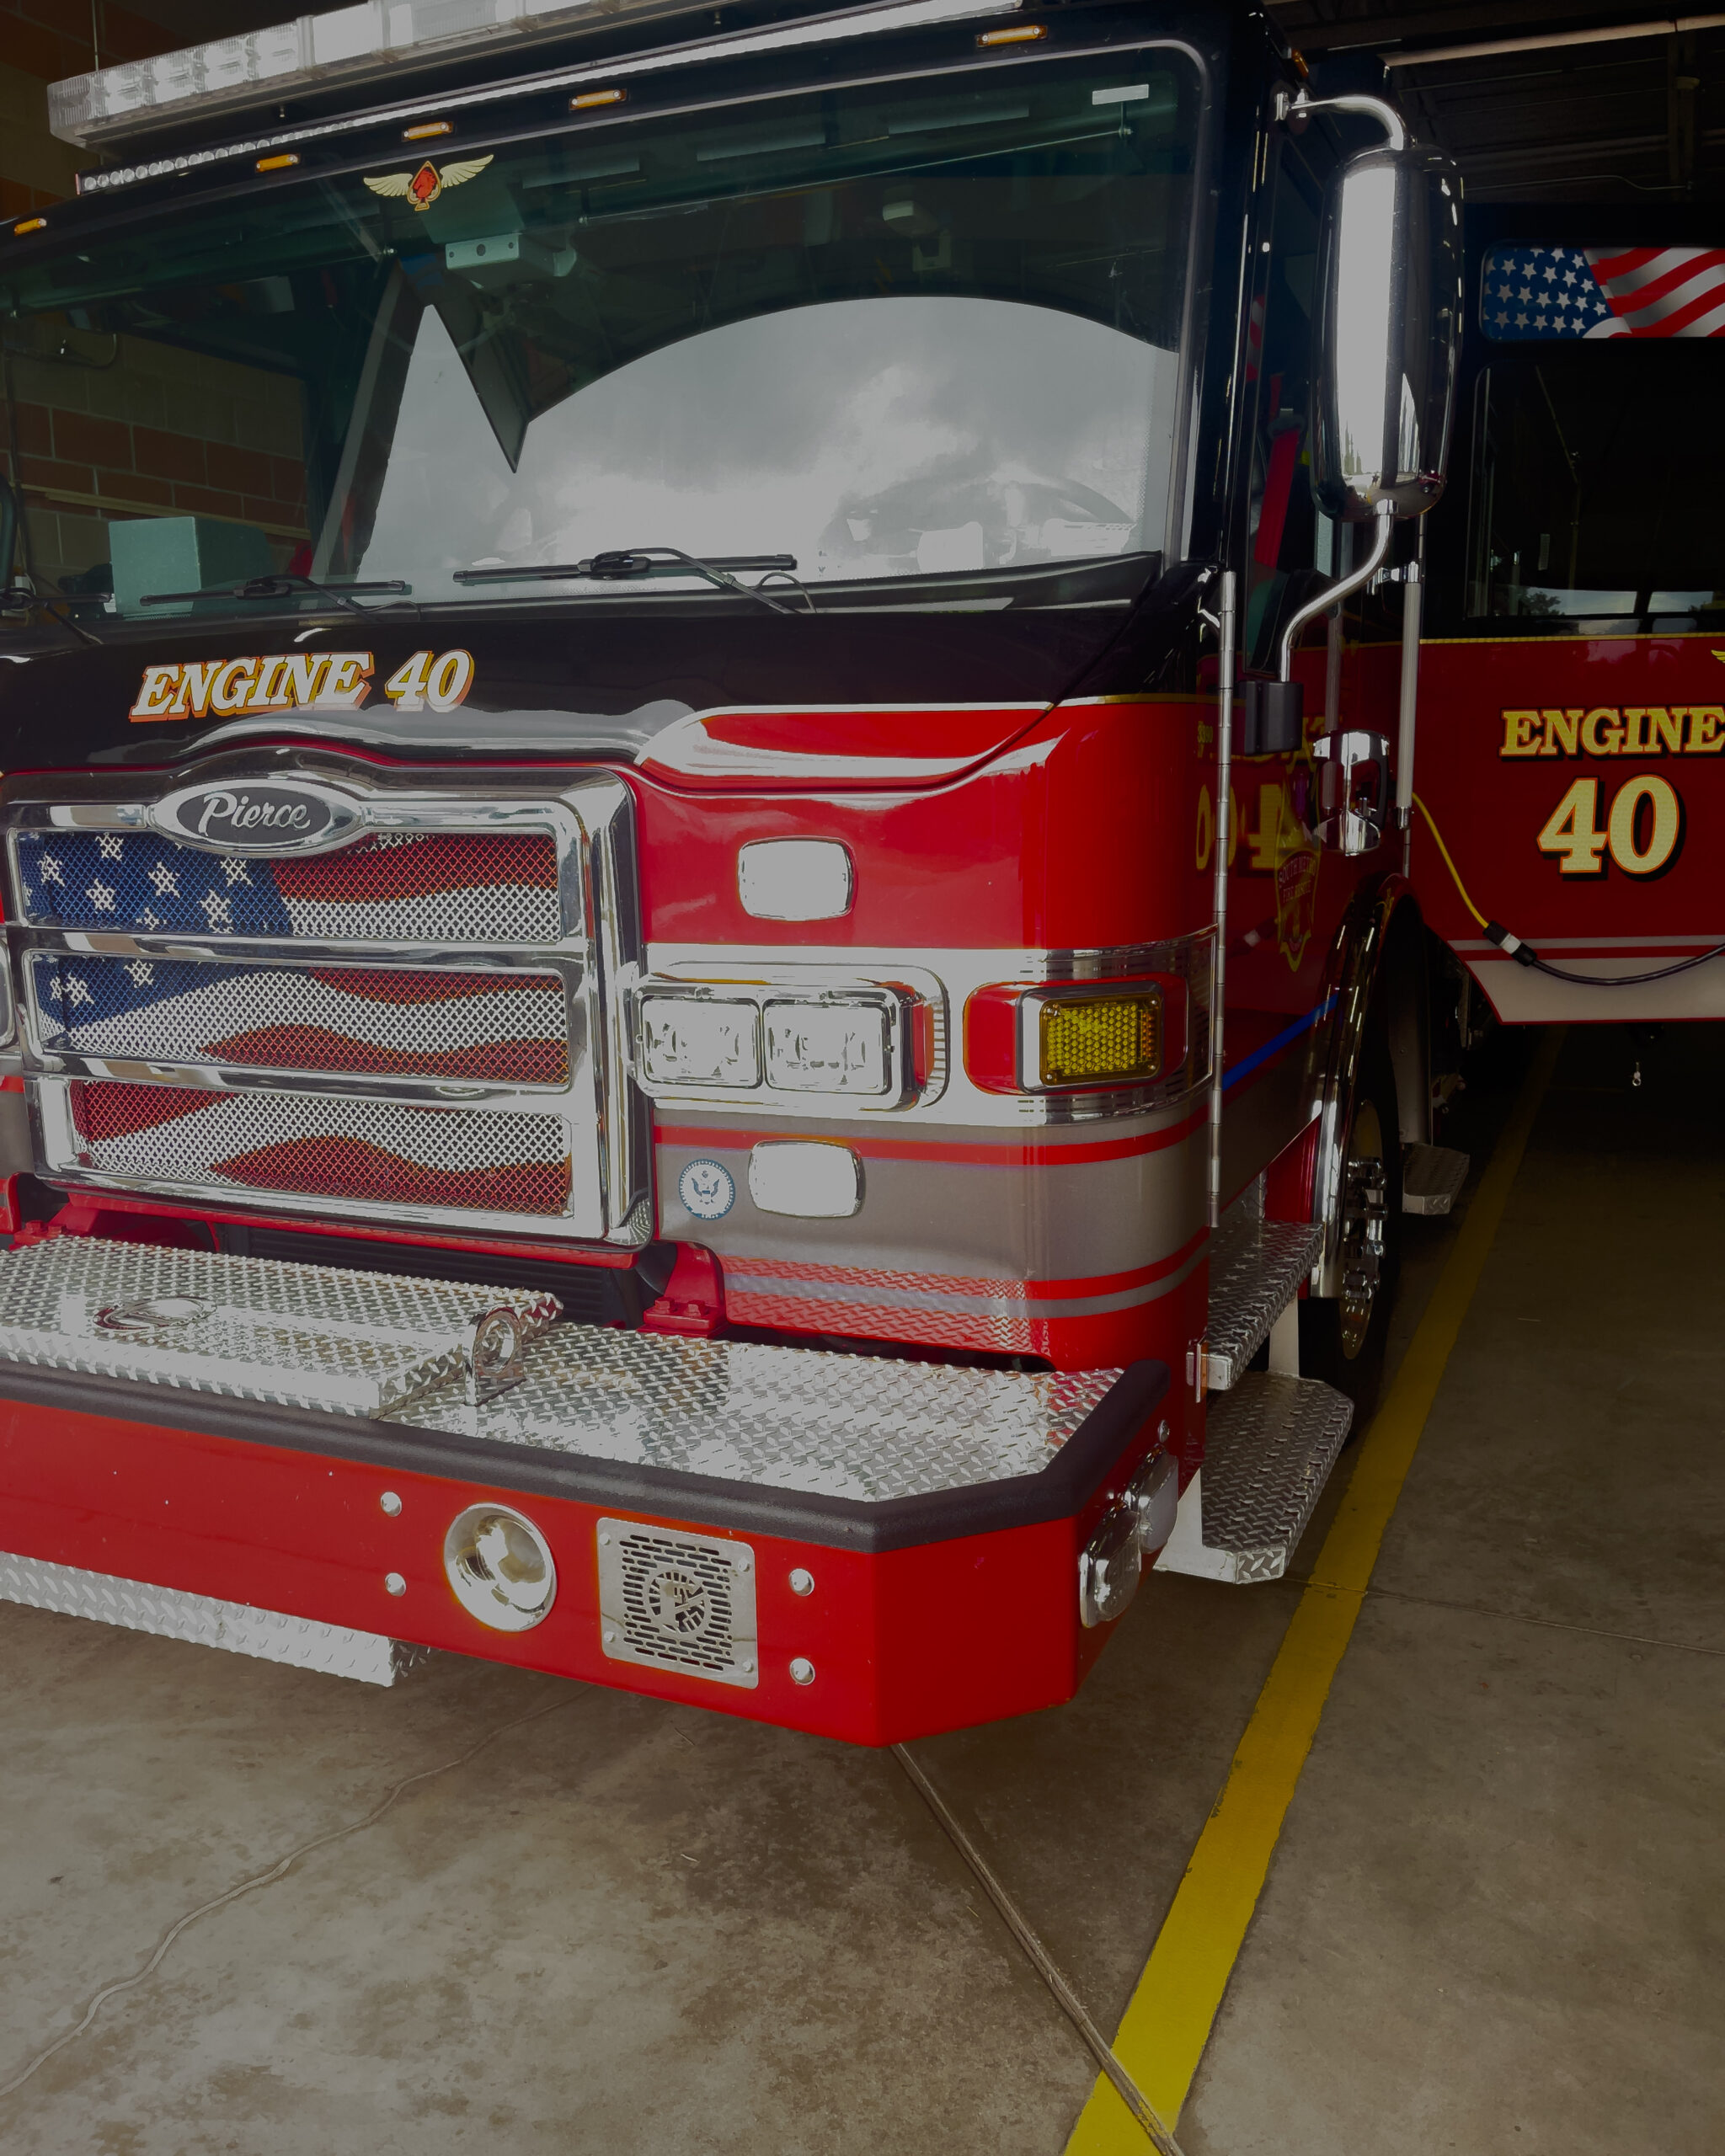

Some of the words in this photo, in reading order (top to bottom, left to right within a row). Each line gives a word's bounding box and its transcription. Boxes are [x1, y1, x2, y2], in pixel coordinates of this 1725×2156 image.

[129, 652, 375, 723] ENGINE
[385, 648, 474, 712] 40
[1500, 705, 1725, 759] ENGINE
[198, 792, 312, 836] Pierce
[1537, 774, 1682, 876] 40
